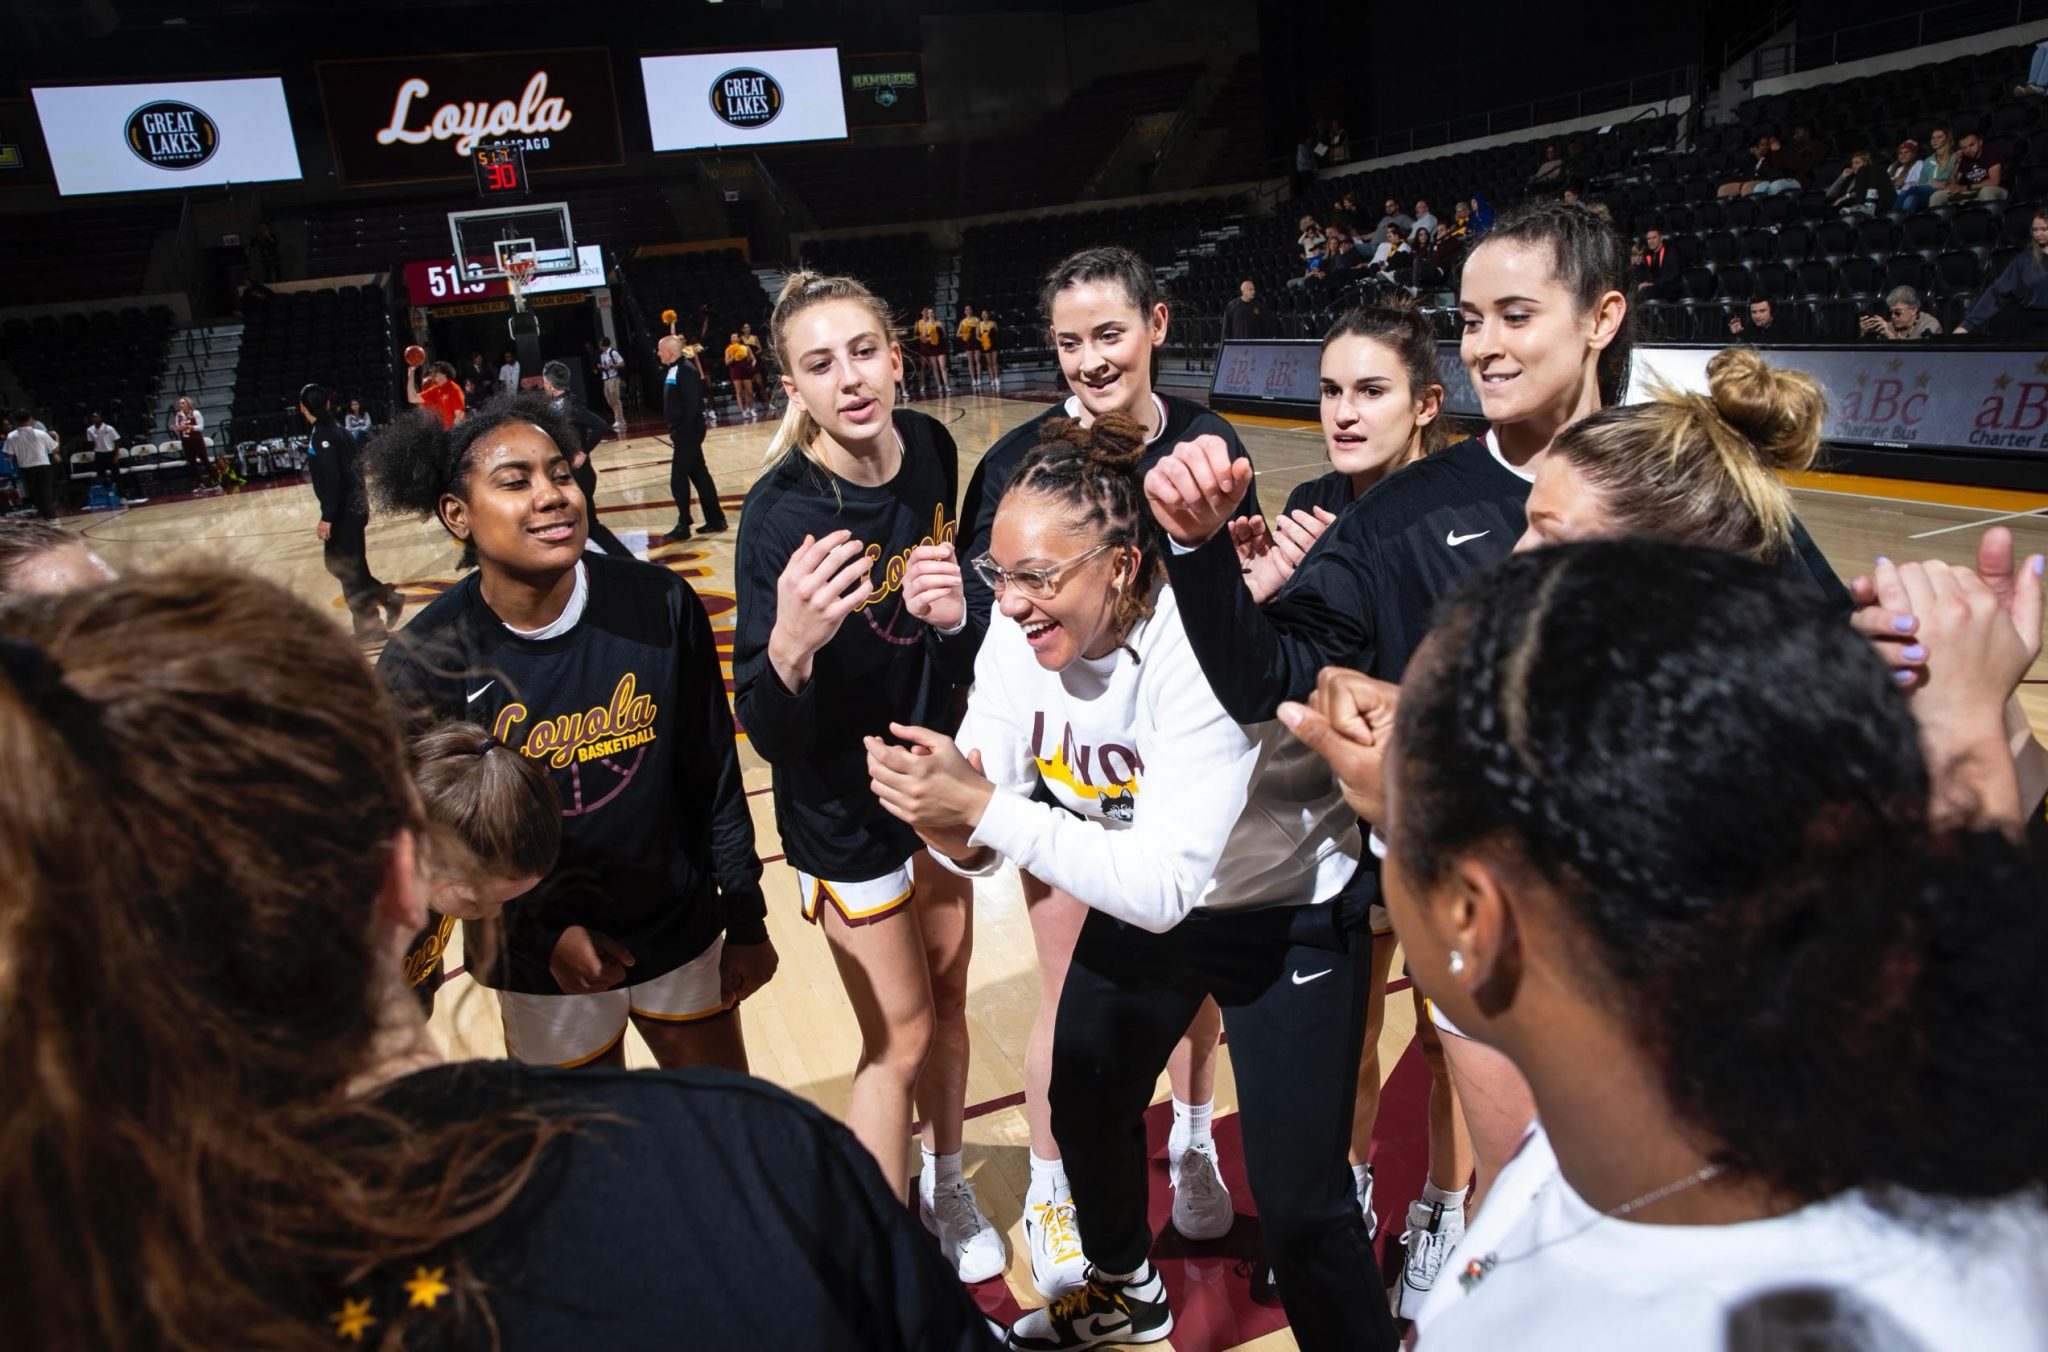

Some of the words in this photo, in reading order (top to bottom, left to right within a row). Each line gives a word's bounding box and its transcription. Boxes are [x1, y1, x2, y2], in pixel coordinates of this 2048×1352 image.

[724, 77, 766, 97] GREAT
[376, 70, 572, 157] Loyola
[727, 96, 769, 116] LAKES
[143, 112, 195, 134] GREAT
[147, 133, 201, 155] LAKES
[486, 164, 517, 190] 30
[1839, 378, 1929, 426] aBc
[1834, 420, 1888, 438] Charter
[1892, 425, 1918, 440] Bus
[1969, 429, 2036, 448] Charter
[577, 727, 657, 763] BASKETBALL
